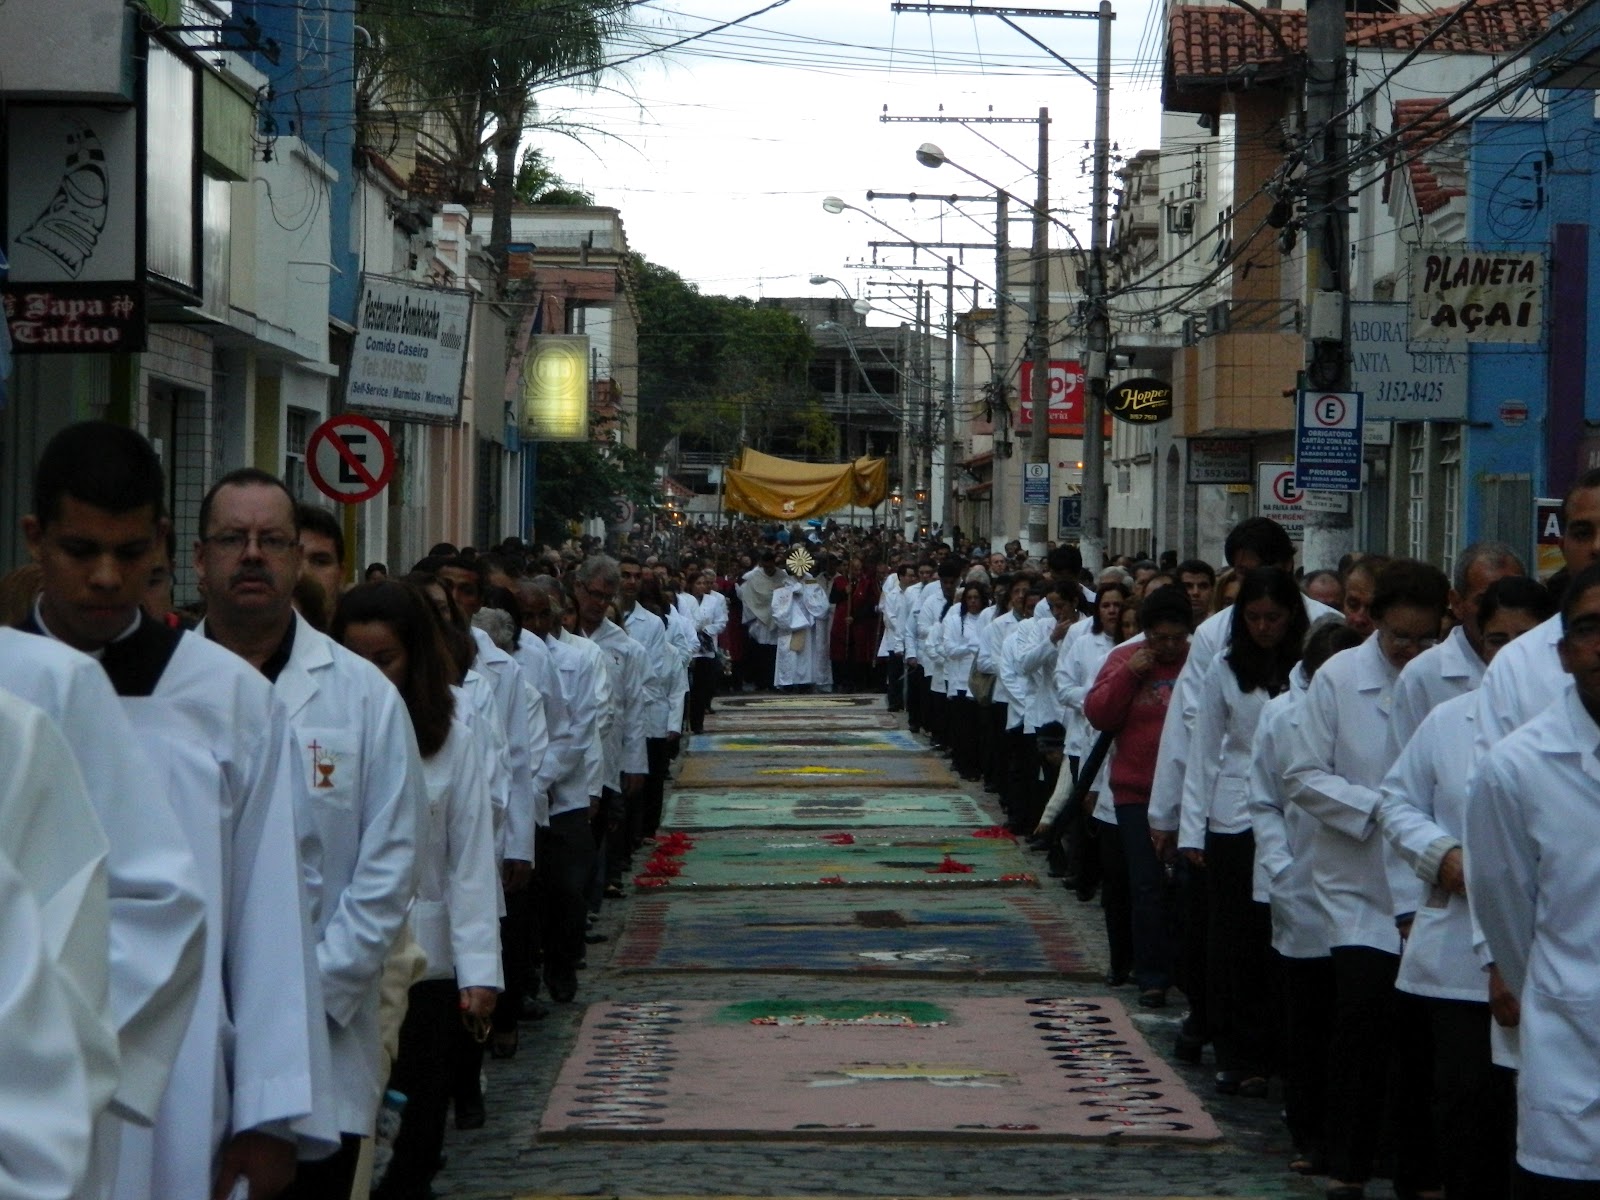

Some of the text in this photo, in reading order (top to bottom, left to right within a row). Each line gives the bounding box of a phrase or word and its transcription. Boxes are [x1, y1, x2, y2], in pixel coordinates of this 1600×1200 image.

[1423, 255, 1535, 293] PLANETA
[362, 289, 402, 333] Restaurante
[1430, 290, 1537, 333] AÇAÍ
[12, 320, 120, 343] Tattoo
[365, 336, 429, 358] Comida Caseira
[1350, 352, 1391, 373] ANTA
[393, 386, 421, 402] Marmitas
[1115, 388, 1170, 410] Hopper
[1377, 381, 1444, 402] 3152-8425
[1326, 403, 1335, 419] E
[1343, 438, 1359, 446] AZUL
[340, 434, 367, 483] E
[1284, 478, 1296, 498] E
